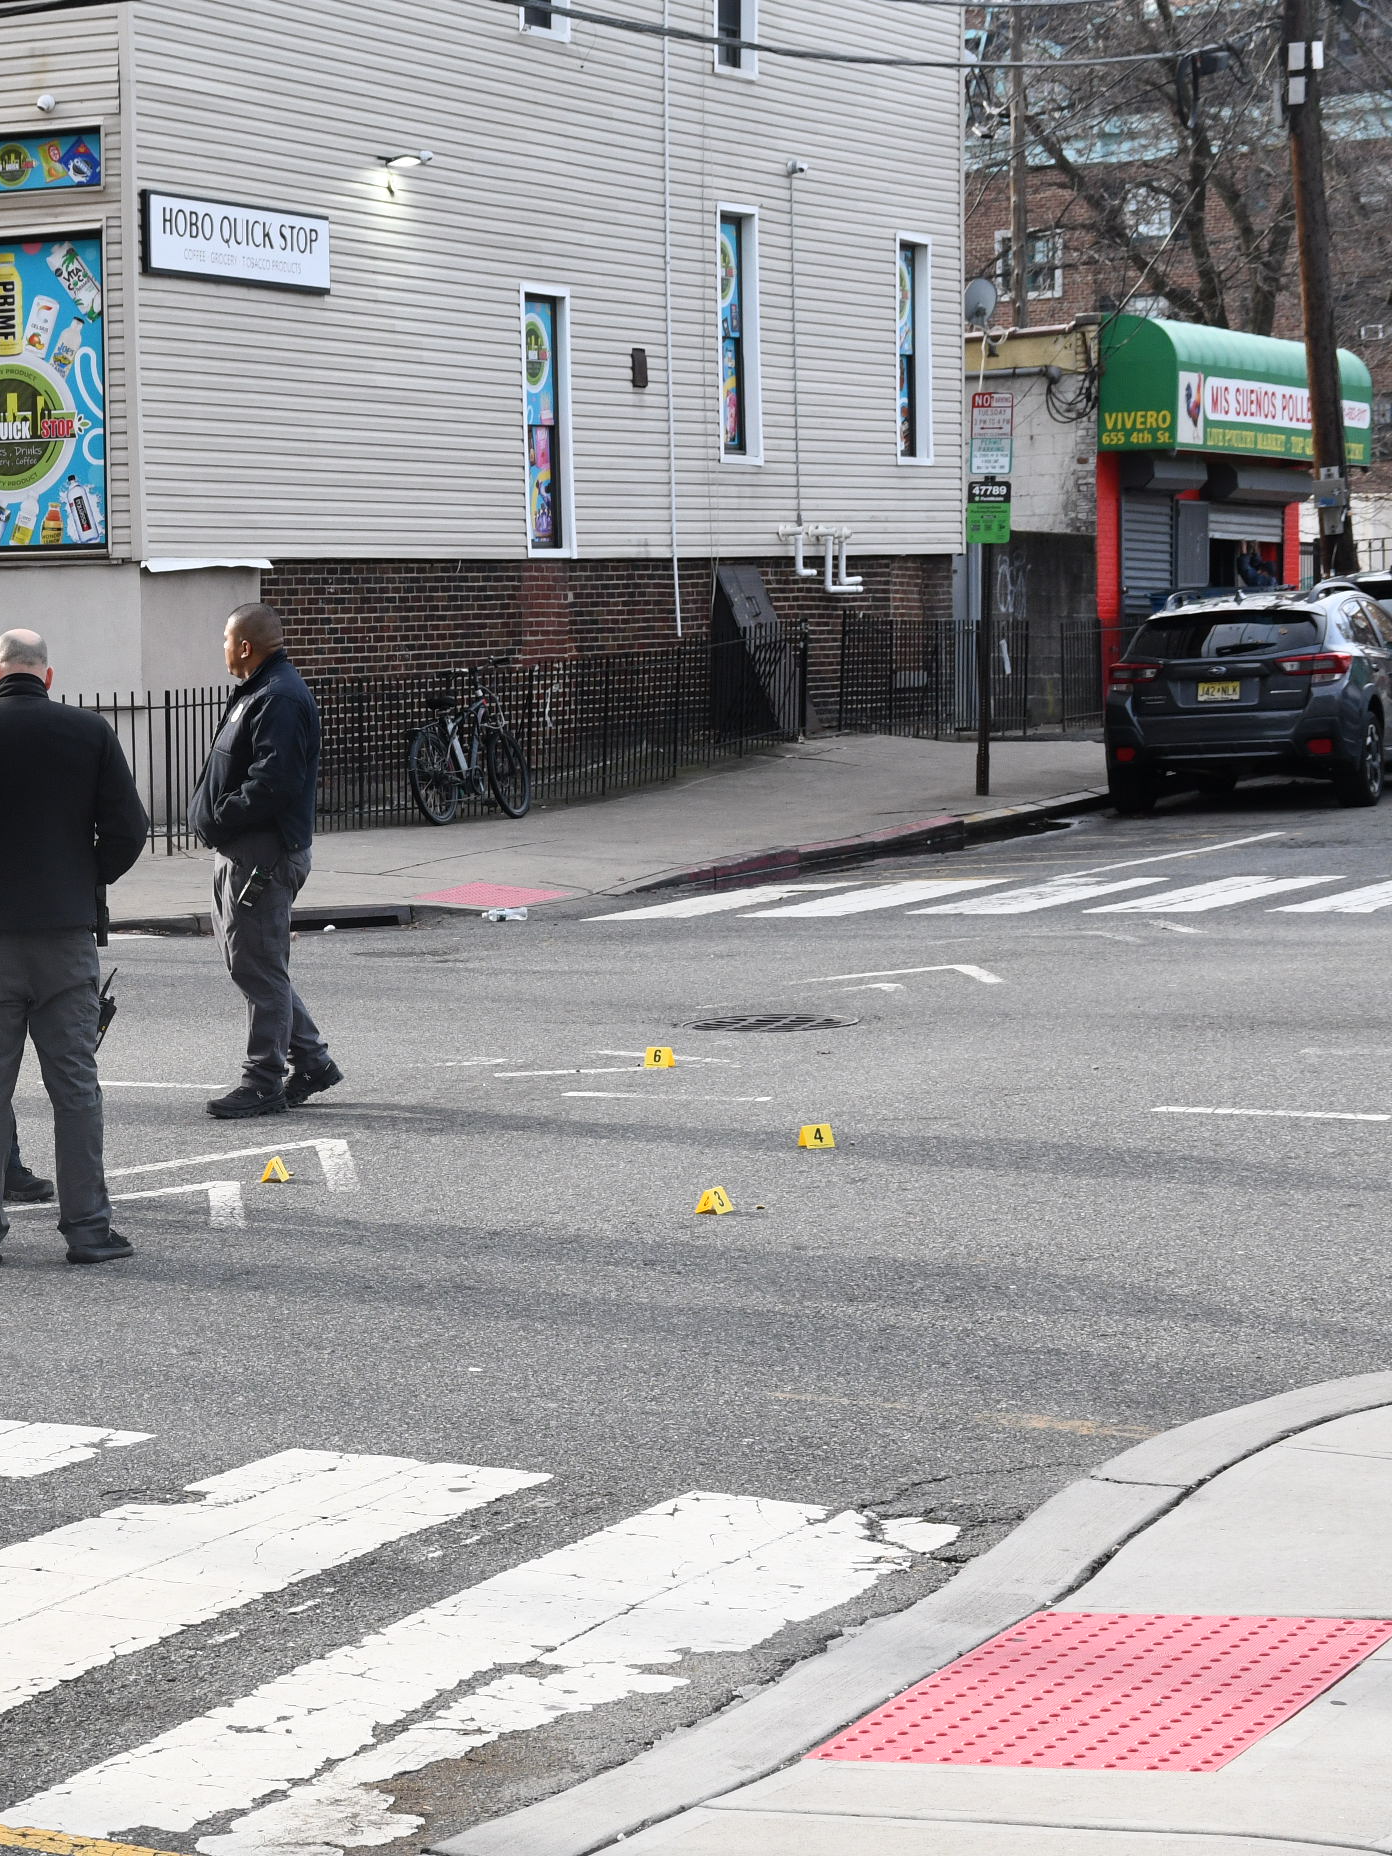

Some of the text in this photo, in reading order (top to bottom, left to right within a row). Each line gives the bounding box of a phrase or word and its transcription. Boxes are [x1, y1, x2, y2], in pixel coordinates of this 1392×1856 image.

[162, 206, 319, 254] HOBO QUICK STOP
[183, 248, 302, 275] COFFEE GROCERY TOBACCO PRODUCTS
[5, 368, 38, 382] PRODUCT
[975, 394, 990, 407] NO
[1211, 385, 1230, 416] MIS
[1235, 387, 1277, 420] SUEÑOS
[1281, 393, 1312, 424] POLLE
[1104, 410, 1172, 431] VIVERO
[41, 419, 74, 438] STOP
[1102, 430, 1173, 445] 655 4th St.
[14, 446, 42, 456] Drinks
[16, 457, 38, 466] Coffee
[8, 472, 39, 486] PRODUCT
[972, 485, 1007, 496] 47789
[653, 1049, 662, 1063] 6
[813, 1128, 824, 1144] 4
[714, 1190, 725, 1207] 3
